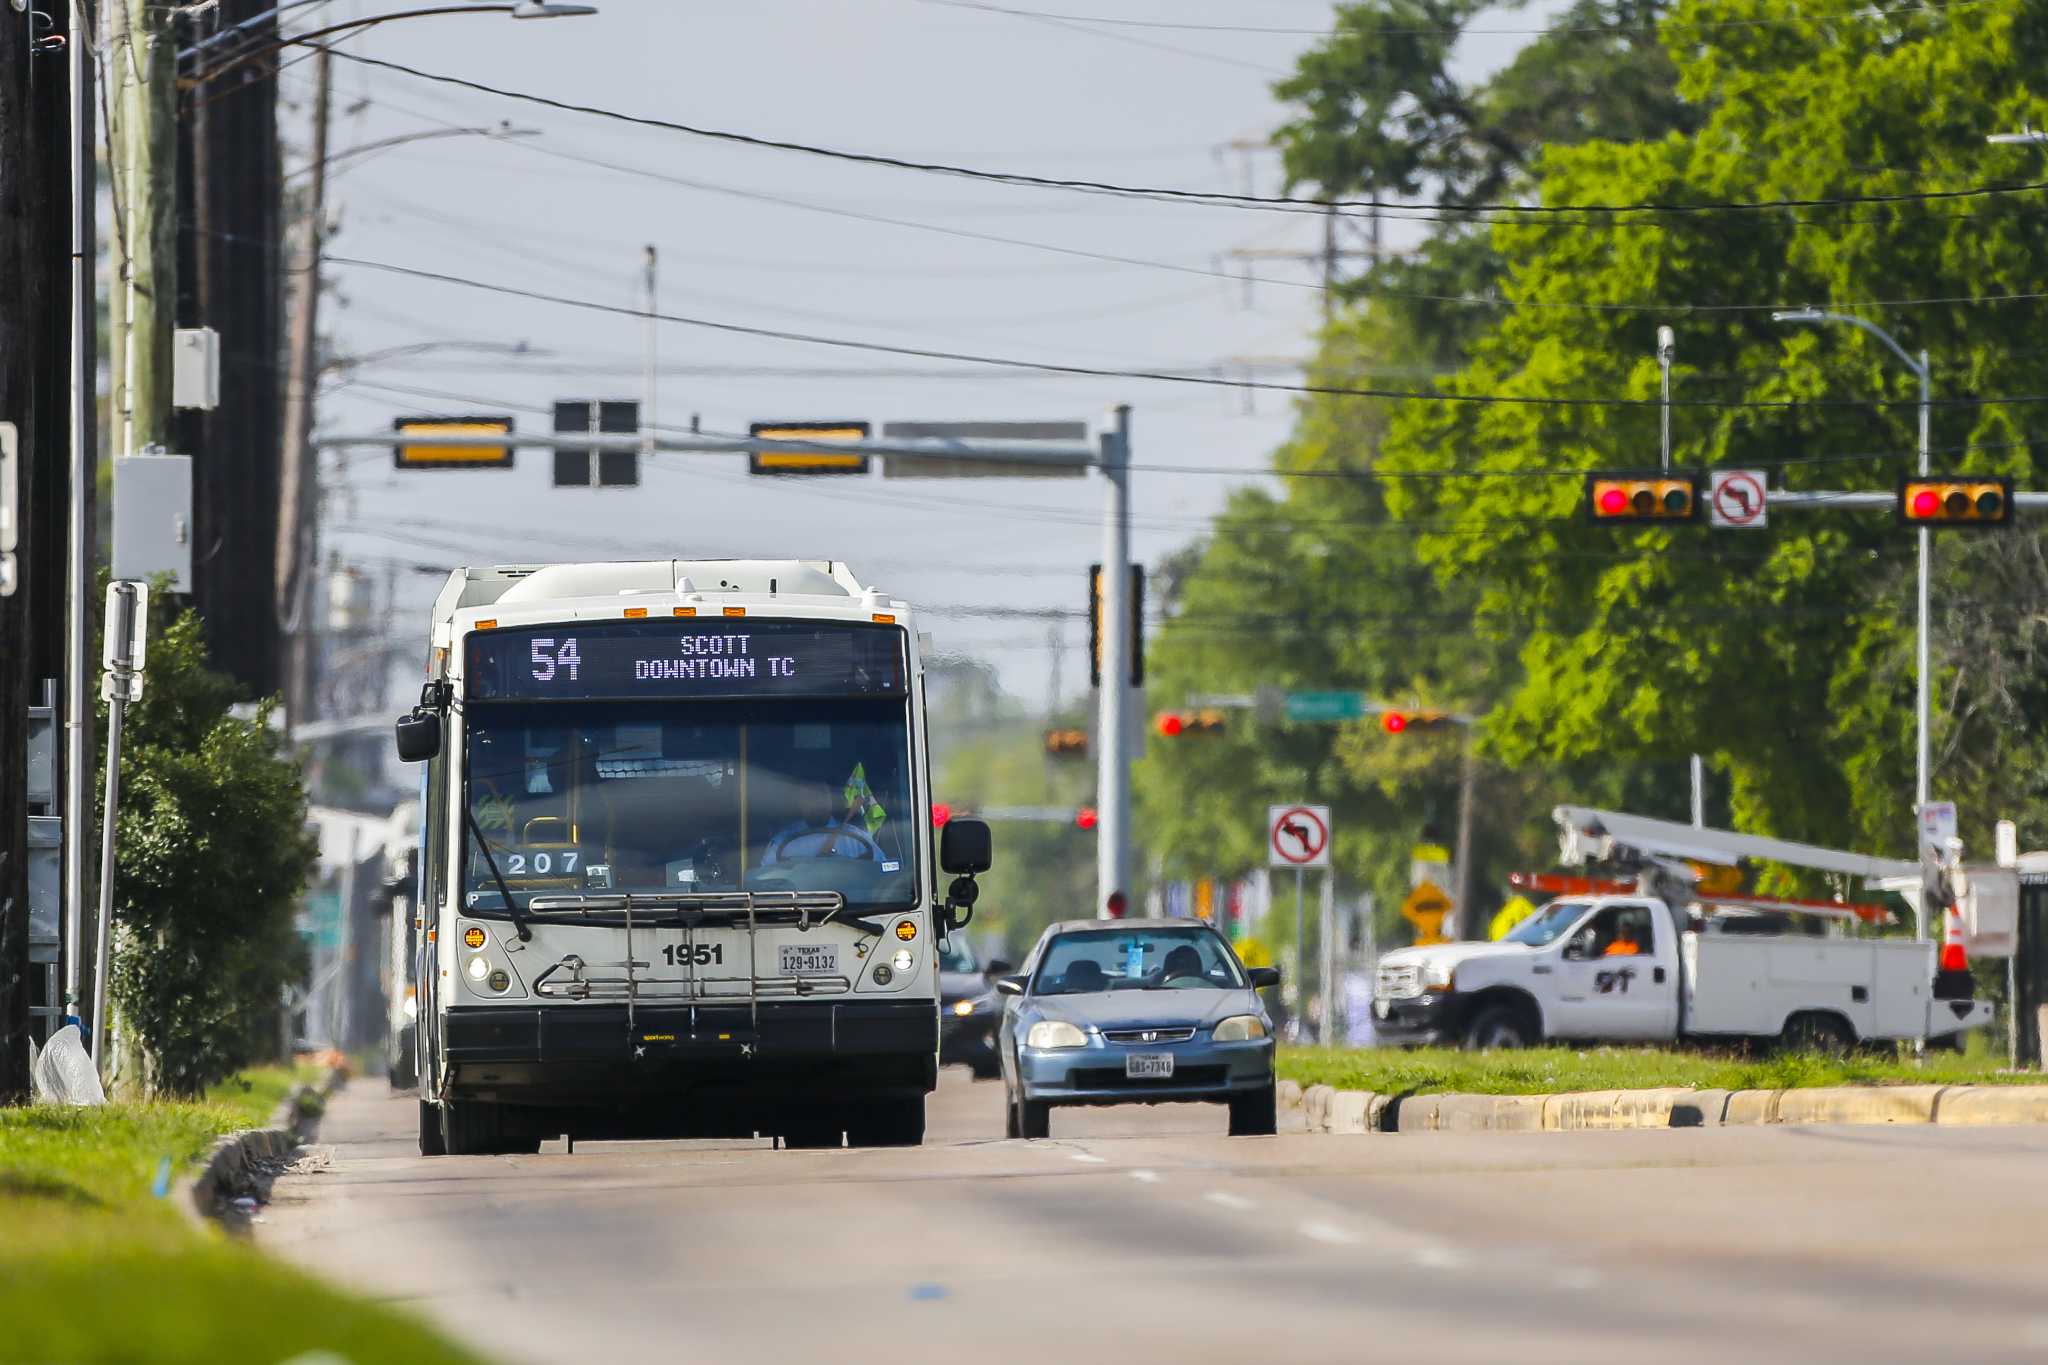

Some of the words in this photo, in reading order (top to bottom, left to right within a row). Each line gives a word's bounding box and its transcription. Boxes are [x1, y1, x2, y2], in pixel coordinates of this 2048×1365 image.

[681, 635, 750, 654] SCOTT
[531, 638, 581, 681] 54
[635, 658, 755, 679] DOWNTOWN
[767, 657, 795, 676] TC
[662, 943, 723, 966] 1951
